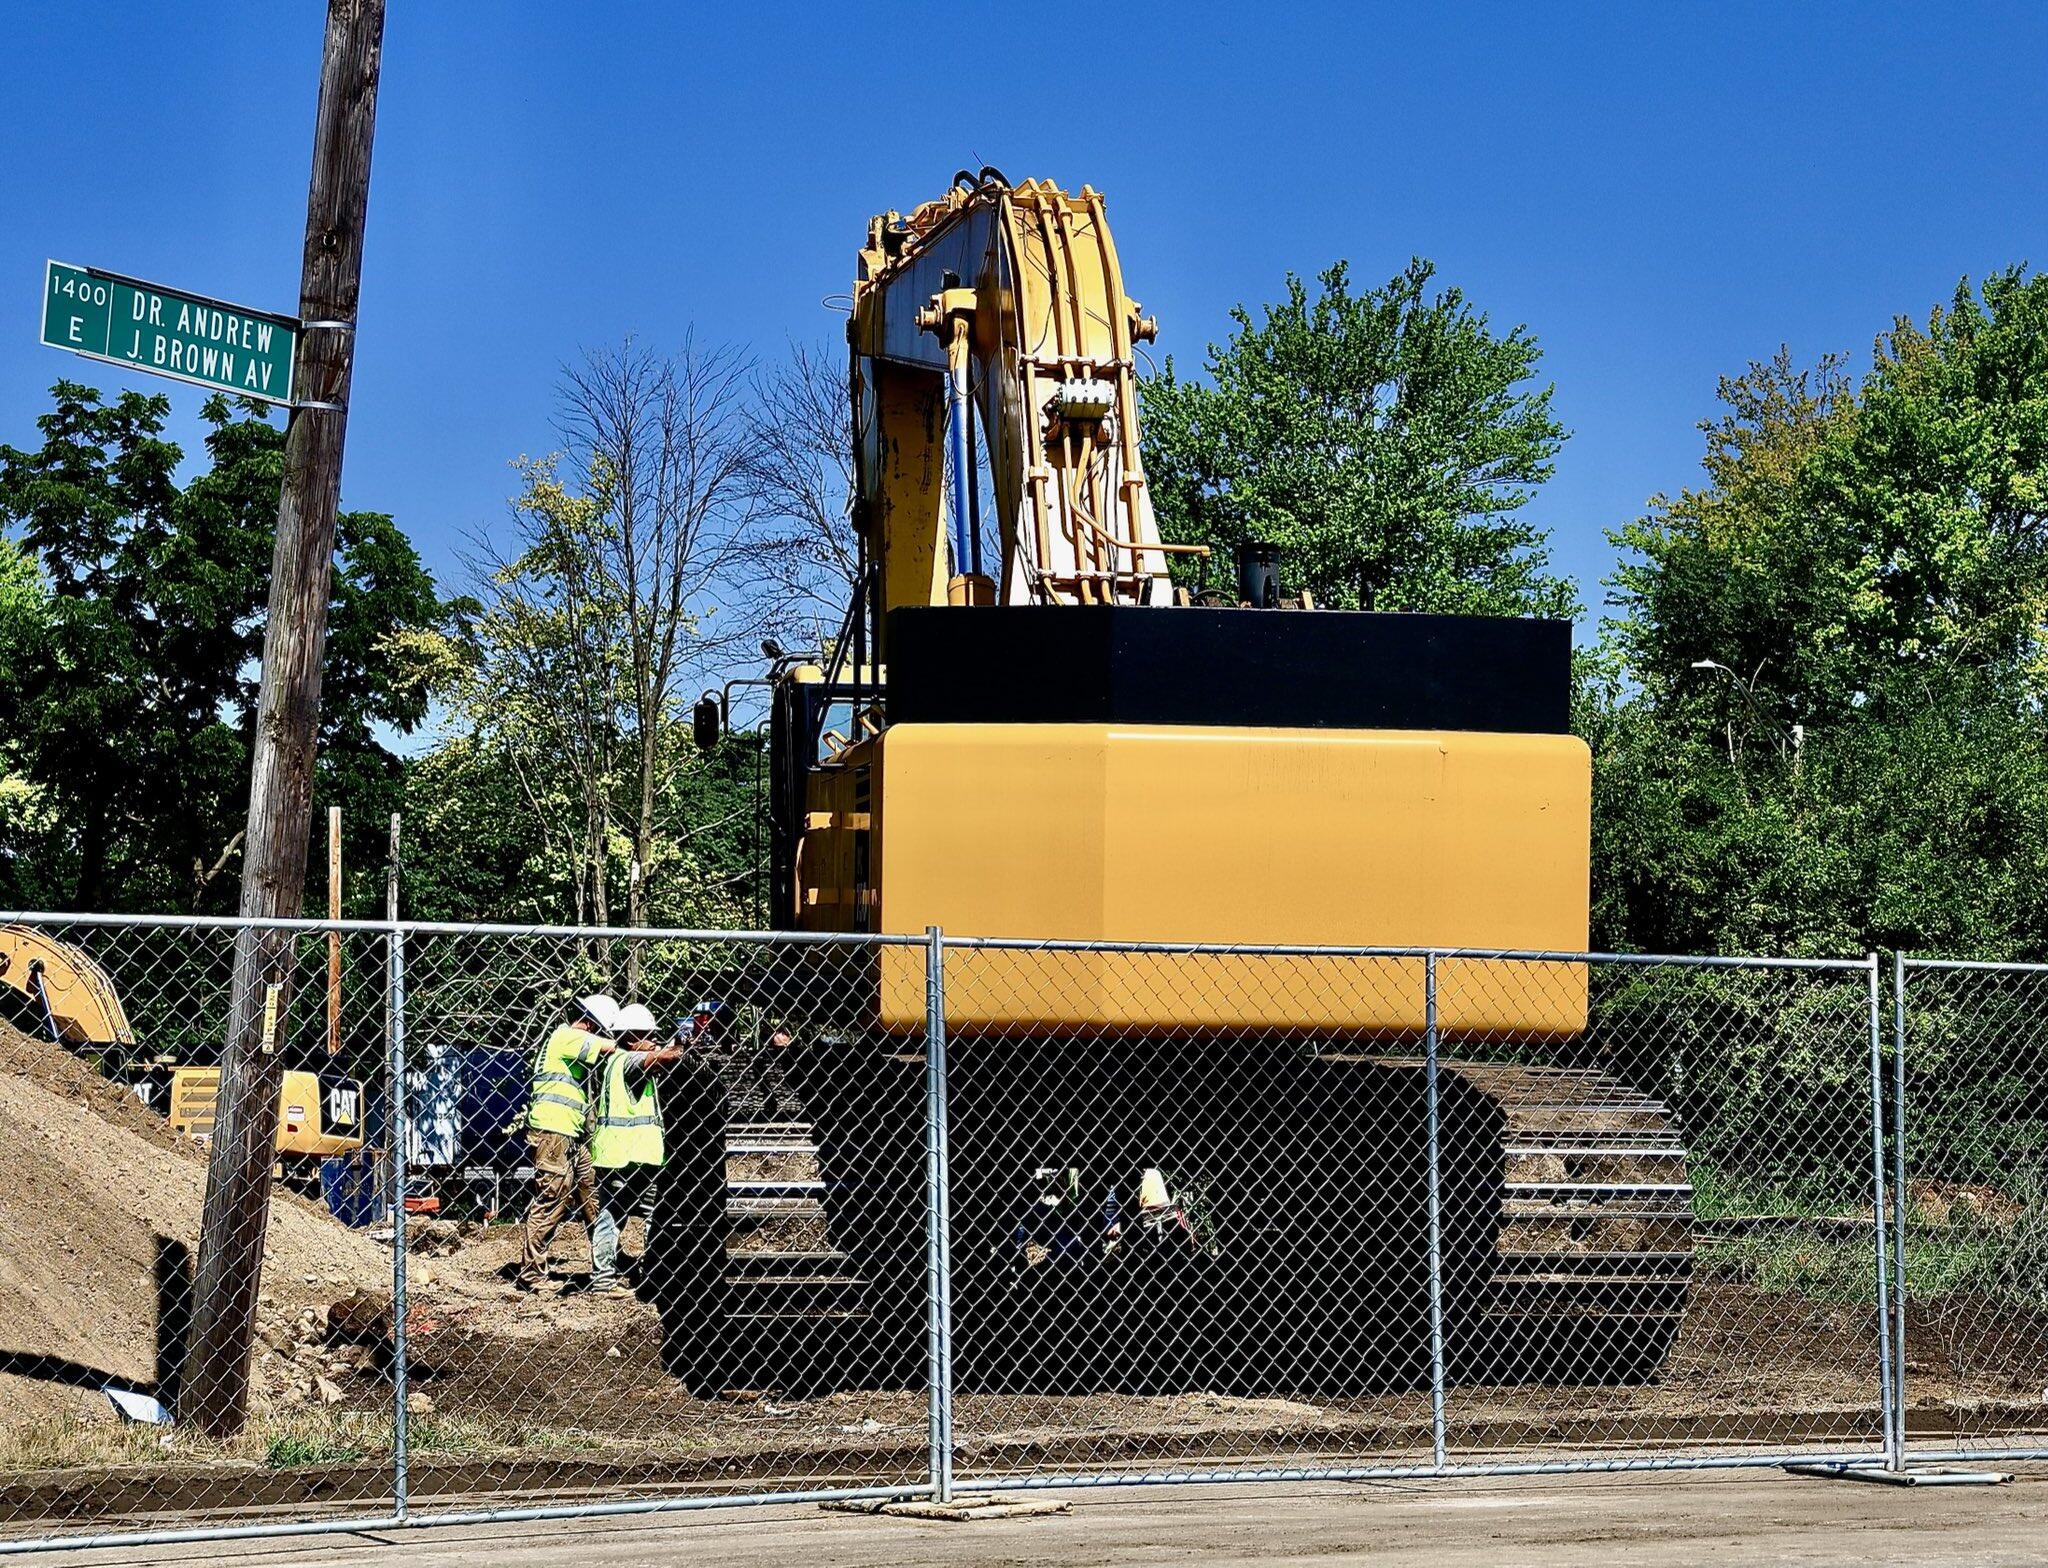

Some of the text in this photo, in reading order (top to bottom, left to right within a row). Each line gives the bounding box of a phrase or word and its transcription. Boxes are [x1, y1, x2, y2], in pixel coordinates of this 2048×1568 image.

[54, 275, 107, 306] 1400
[69, 316, 84, 343] E
[133, 290, 273, 354] DR. ANDREW
[126, 329, 273, 391] J. BROWN AV
[133, 1083, 152, 1105] AT
[331, 1088, 357, 1125] CAT
